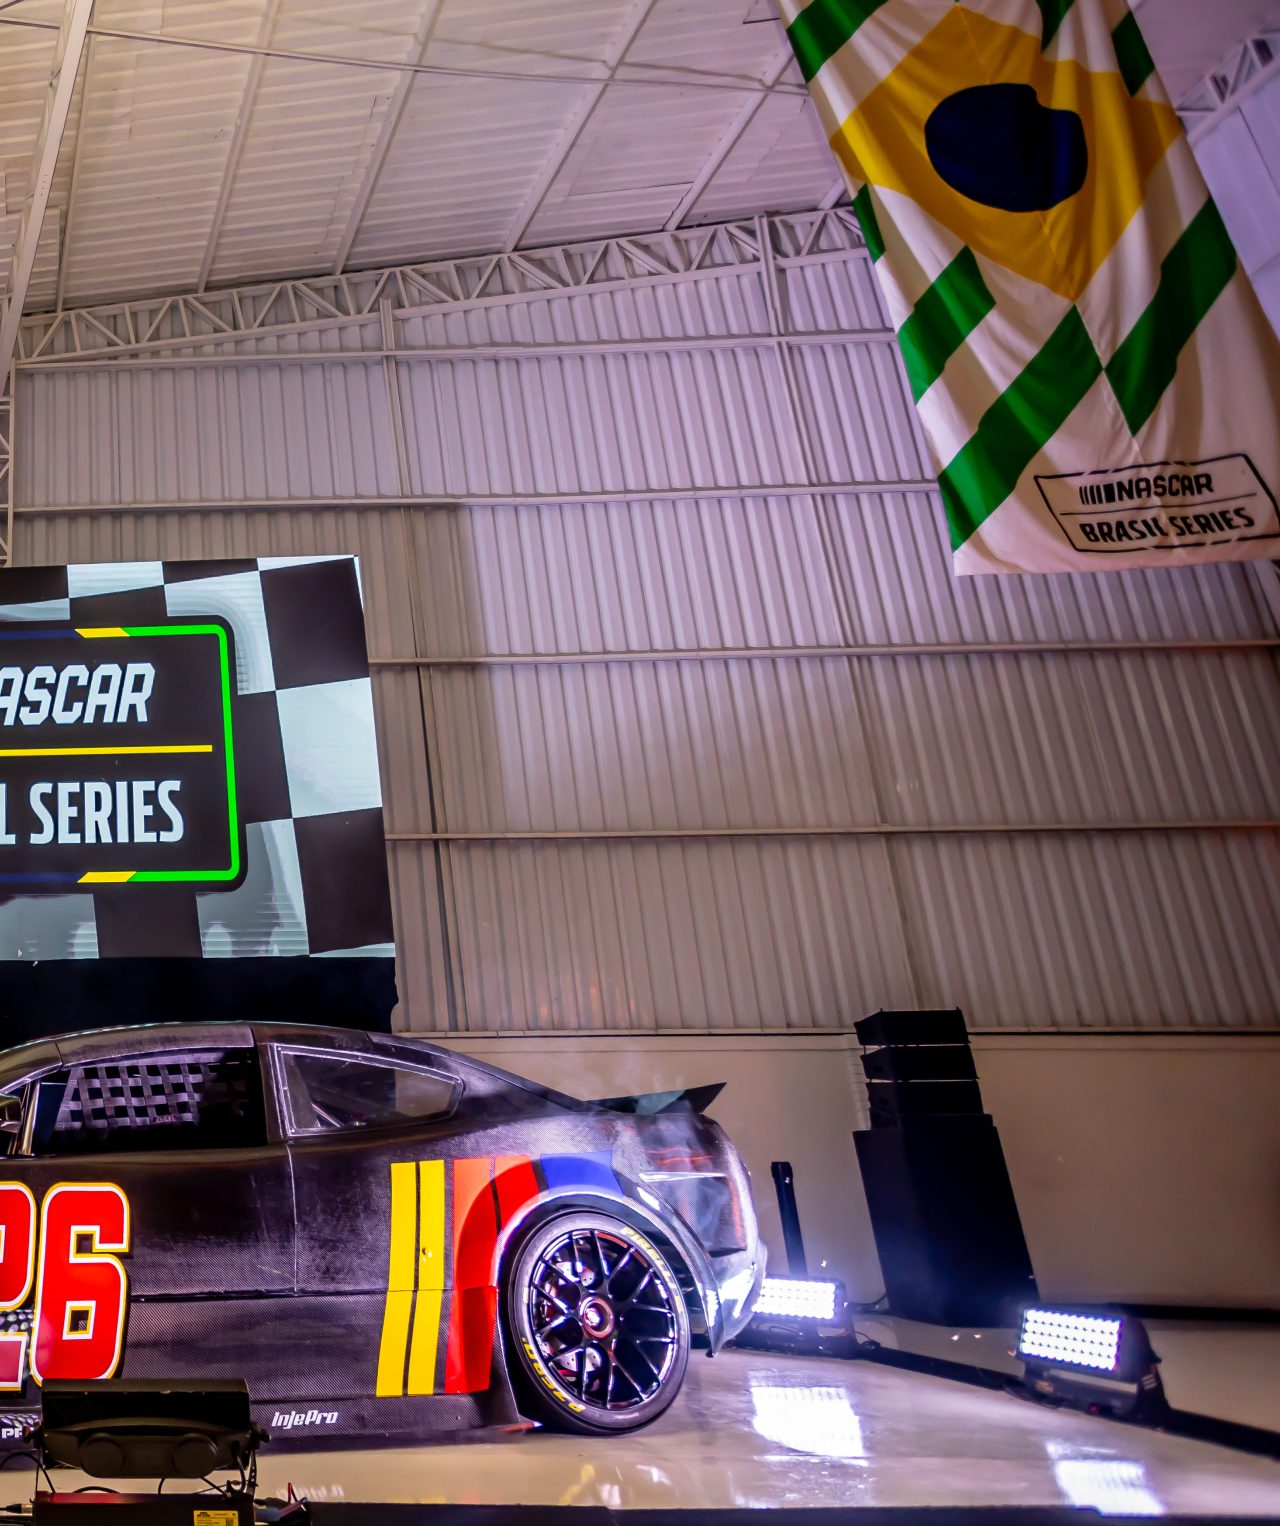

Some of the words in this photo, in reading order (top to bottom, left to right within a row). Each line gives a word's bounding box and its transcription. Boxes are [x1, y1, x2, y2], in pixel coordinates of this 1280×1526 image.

[1116, 472, 1215, 502] NASCAR
[1079, 517, 1167, 543] BRASIL
[1169, 507, 1256, 537] SERIES
[29, 779, 185, 845] SERIES
